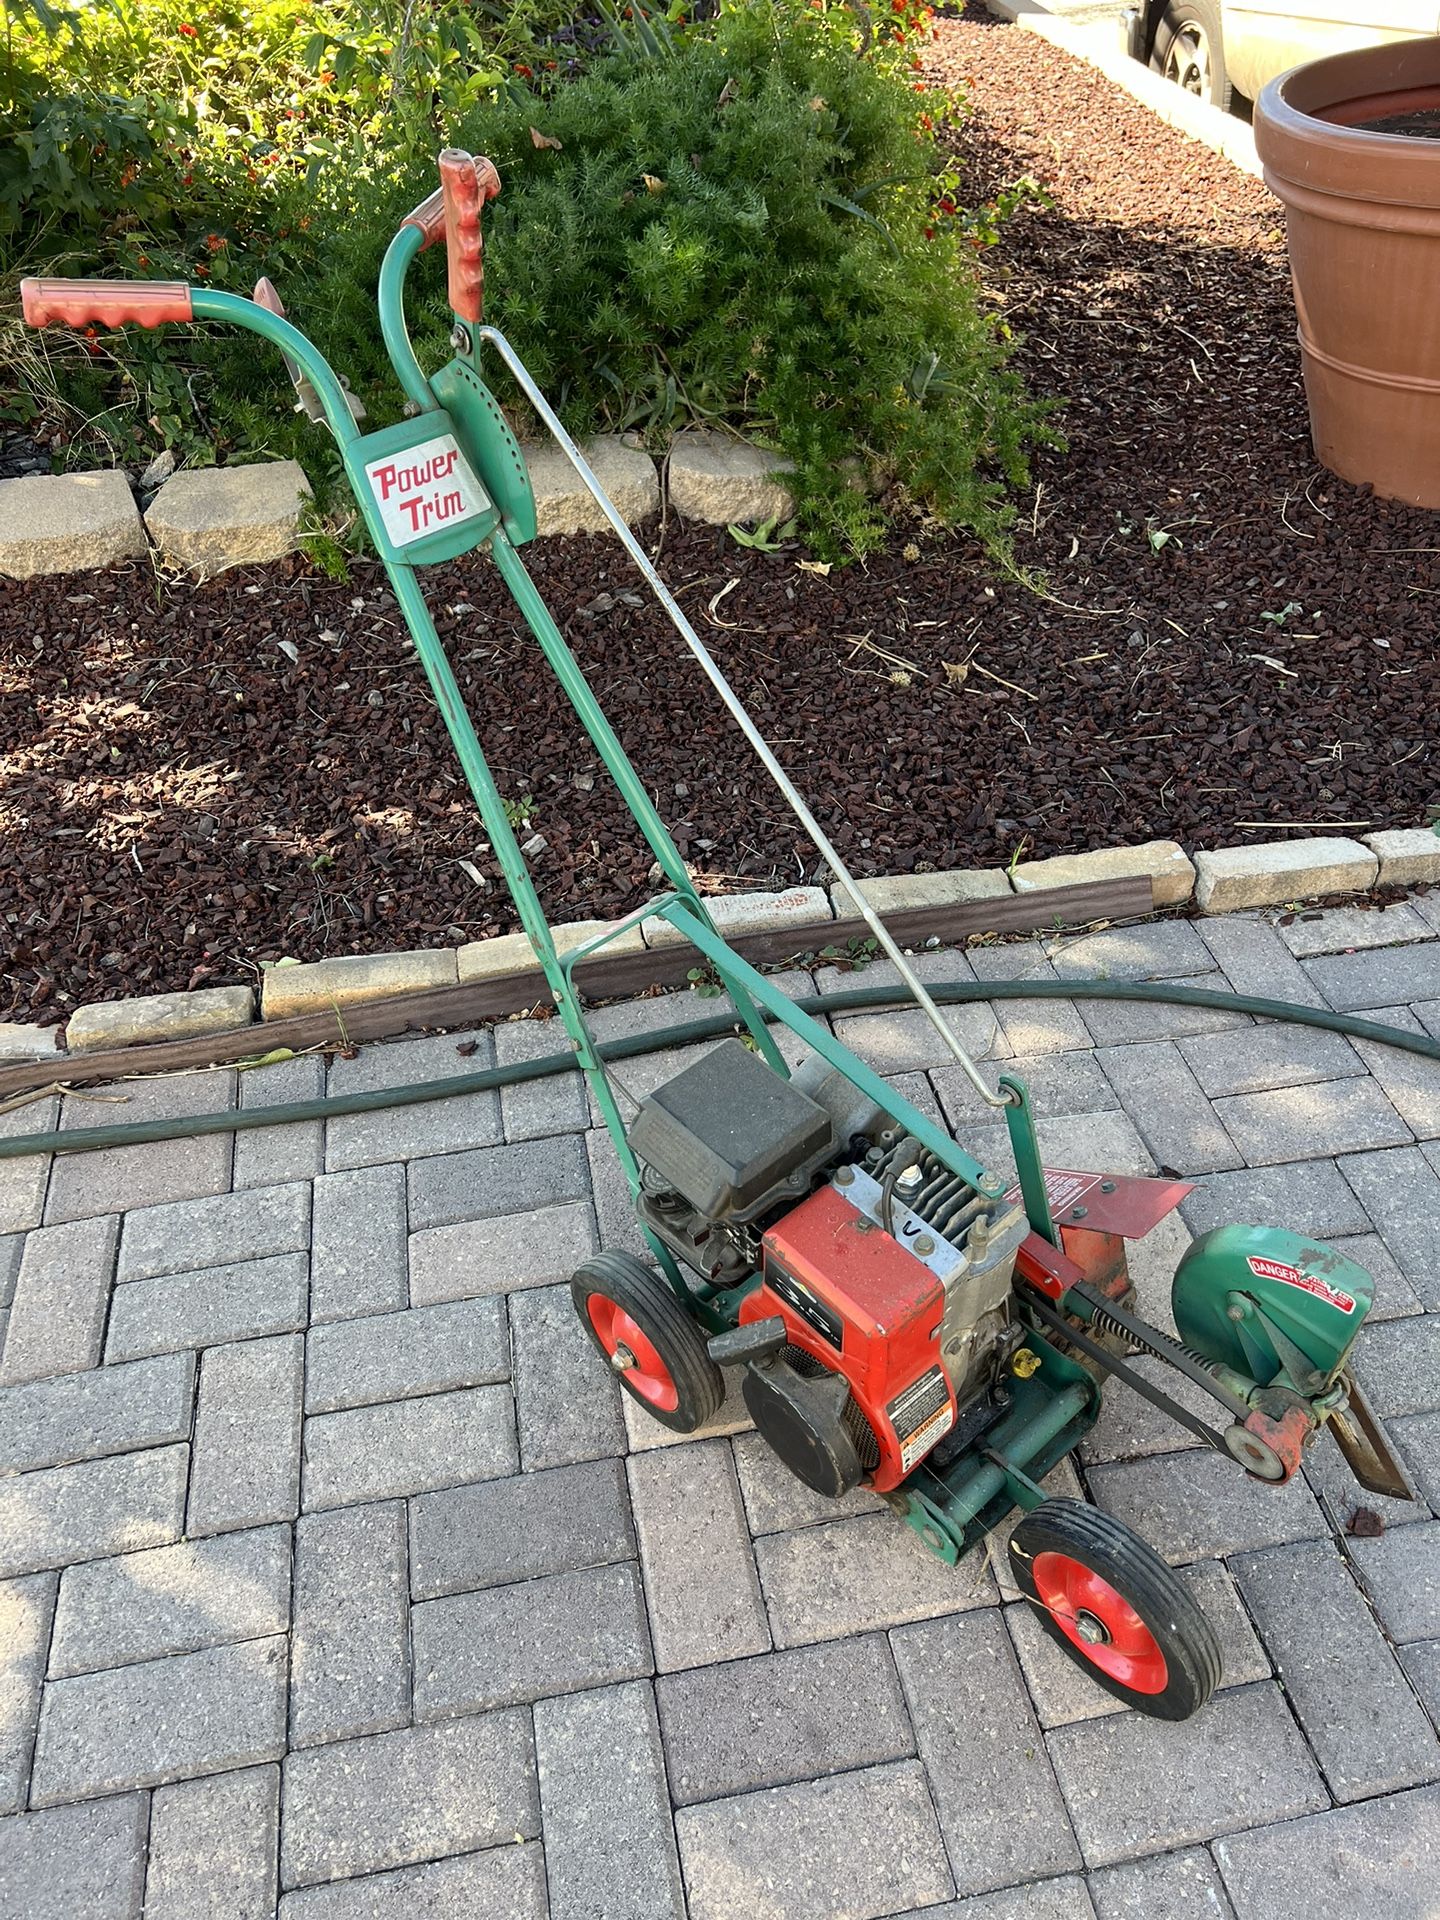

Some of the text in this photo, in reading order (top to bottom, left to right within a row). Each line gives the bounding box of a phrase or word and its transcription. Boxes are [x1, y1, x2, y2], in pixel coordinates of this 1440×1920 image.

[372, 450, 458, 500] Power
[399, 492, 467, 531] Trim
[1252, 1261, 1298, 1282] DANGER
[776, 1277, 831, 1334] 3.5
[913, 1408, 944, 1438] WARNING
